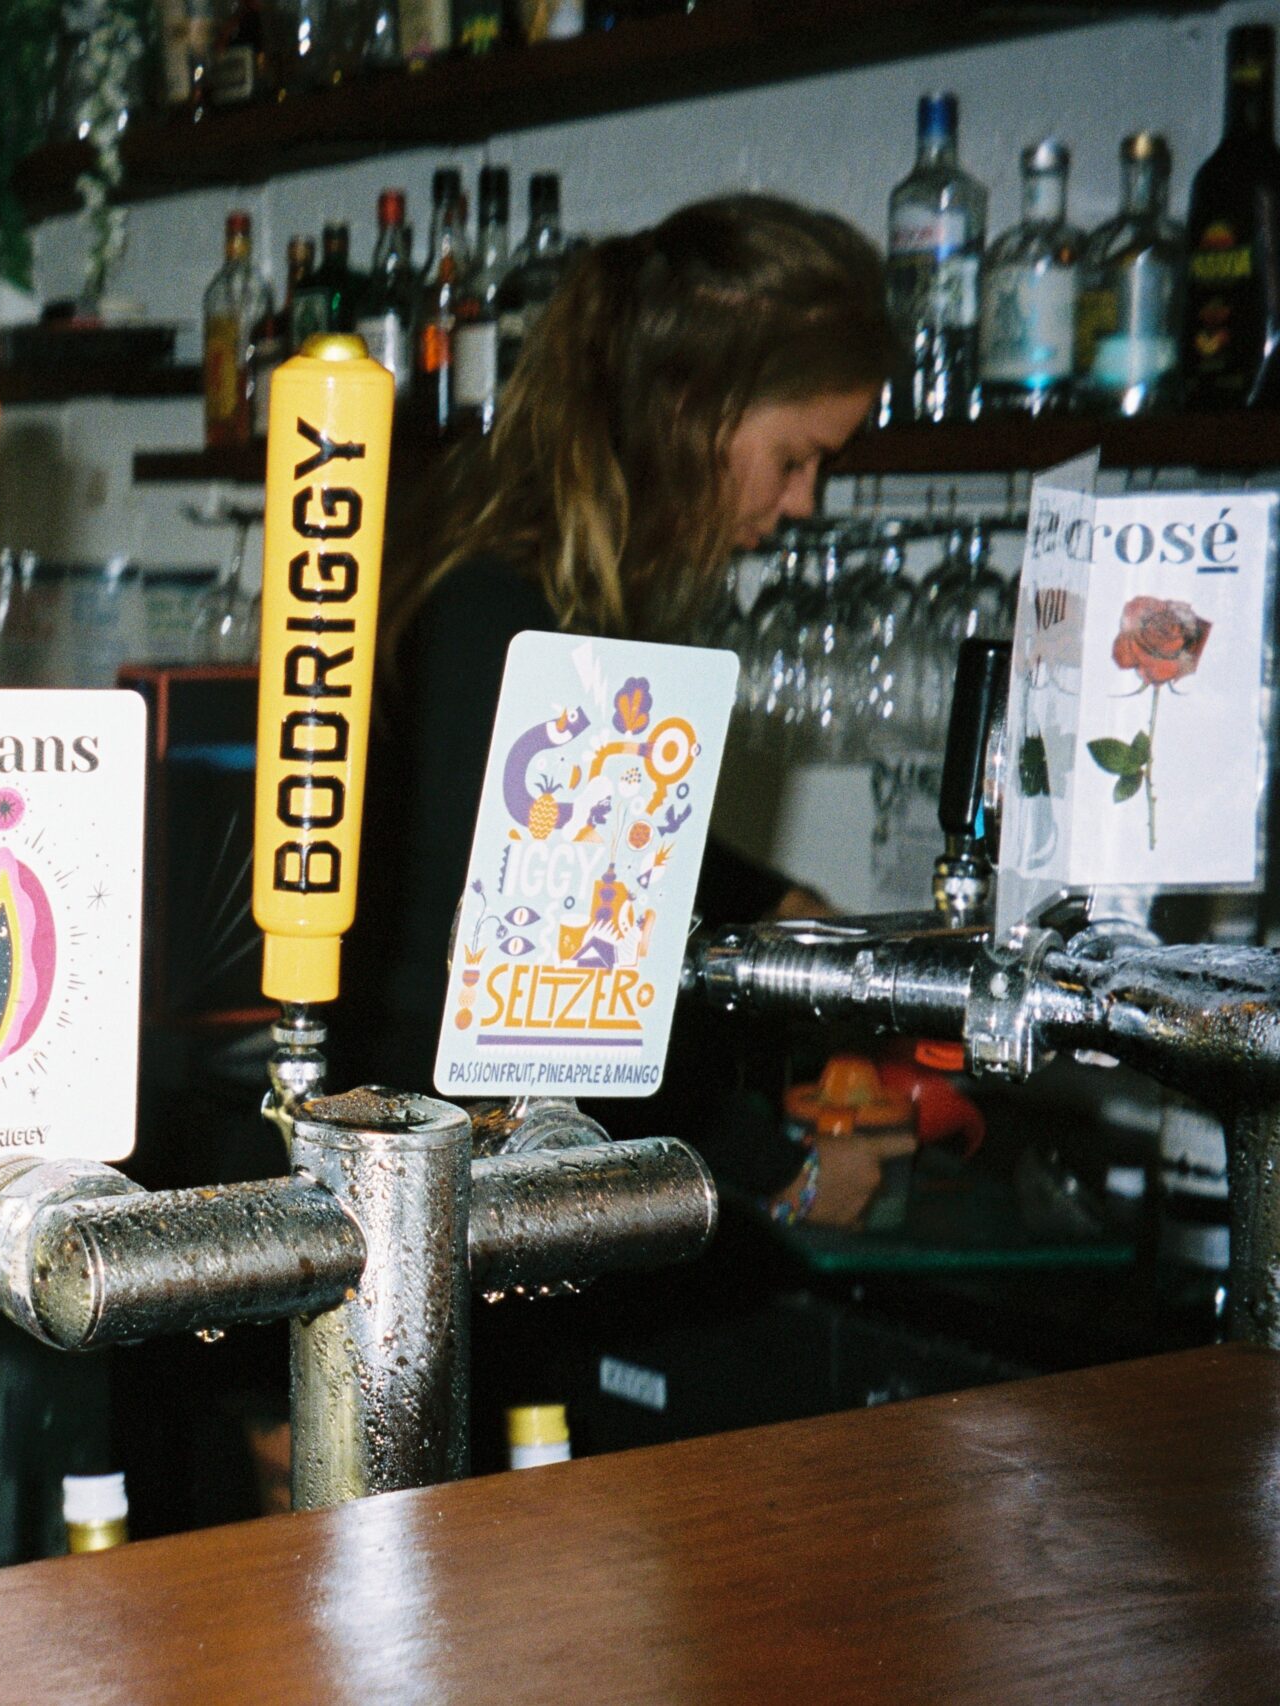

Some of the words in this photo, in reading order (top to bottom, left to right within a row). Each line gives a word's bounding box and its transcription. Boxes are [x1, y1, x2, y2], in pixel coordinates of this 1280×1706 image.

[273, 415, 366, 895] BODRIGGY
[502, 841, 608, 900] IGGY
[480, 962, 643, 1030] SELTZER
[448, 1062, 535, 1086] PASSIONFRUIT,
[537, 1063, 602, 1083] PINEAPPLE
[603, 1064, 613, 1083] &
[613, 1063, 660, 1084] MANGO
